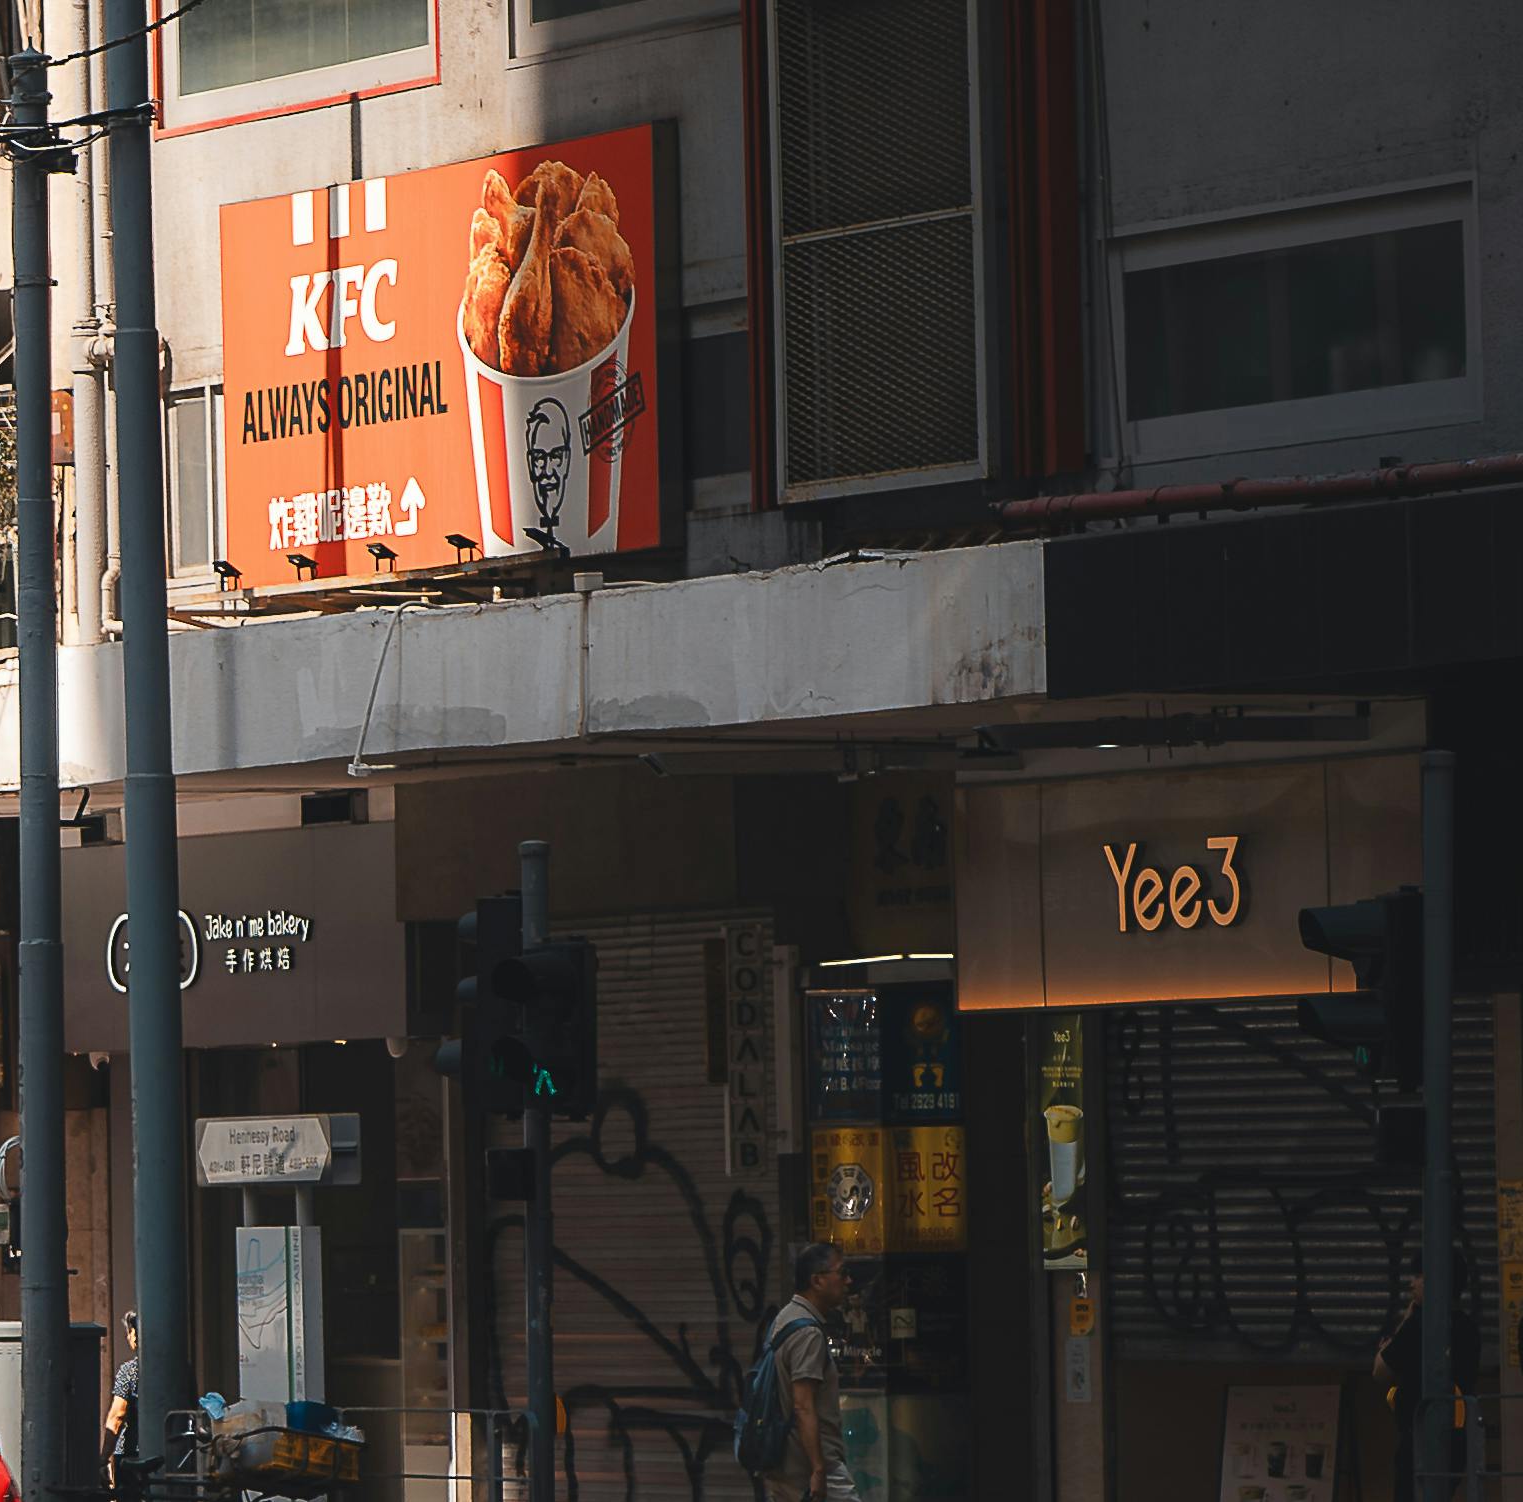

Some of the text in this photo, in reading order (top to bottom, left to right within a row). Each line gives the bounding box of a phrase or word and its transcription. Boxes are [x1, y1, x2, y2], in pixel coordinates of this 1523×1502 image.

[284, 257, 398, 357] KFC
[242, 360, 448, 445] ALWAYS ORIGINAL
[584, 383, 642, 448] HANDMADE
[1102, 834, 1243, 933] Yee3
[205, 914, 233, 941] Jake
[267, 910, 309, 942] bakery
[225, 945, 291, 974] 手作烘焙
[229, 1126, 295, 1146] Hennessy Road
[241, 1153, 286, 1176] 軒尼詩道
[931, 1151, 961, 1218] 改名
[292, 1233, 302, 1306] COASTLINE
